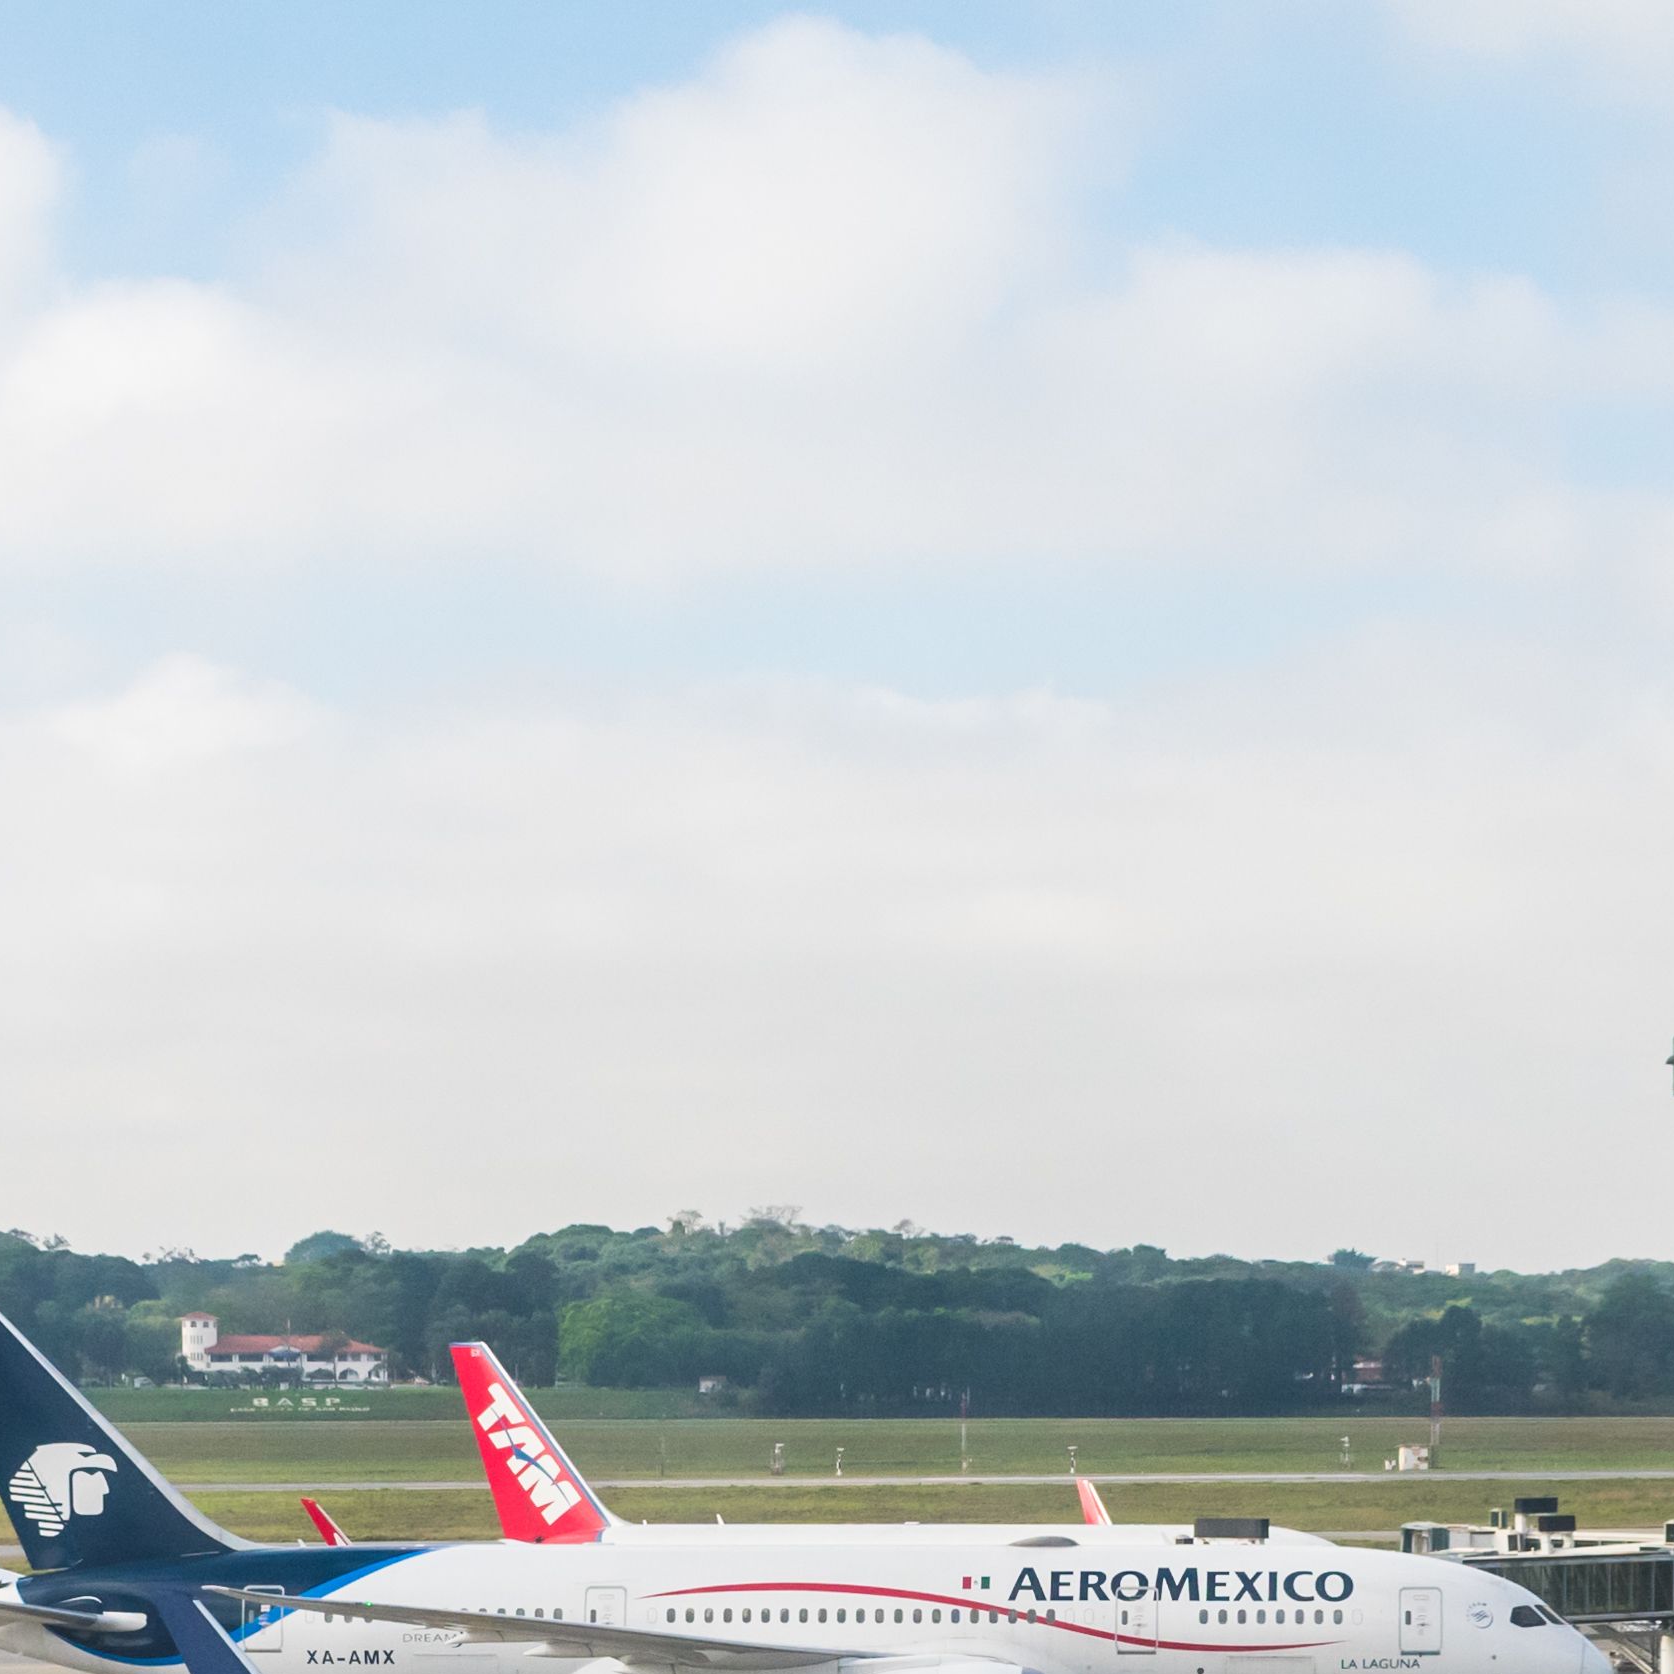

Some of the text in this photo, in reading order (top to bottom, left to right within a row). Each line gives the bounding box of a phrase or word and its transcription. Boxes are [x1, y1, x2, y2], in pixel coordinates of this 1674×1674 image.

[477, 1382, 582, 1526] TAM
[306, 1649, 396, 1665] XA-AMX
[1340, 1658, 1421, 1670] LA LAGUNA
